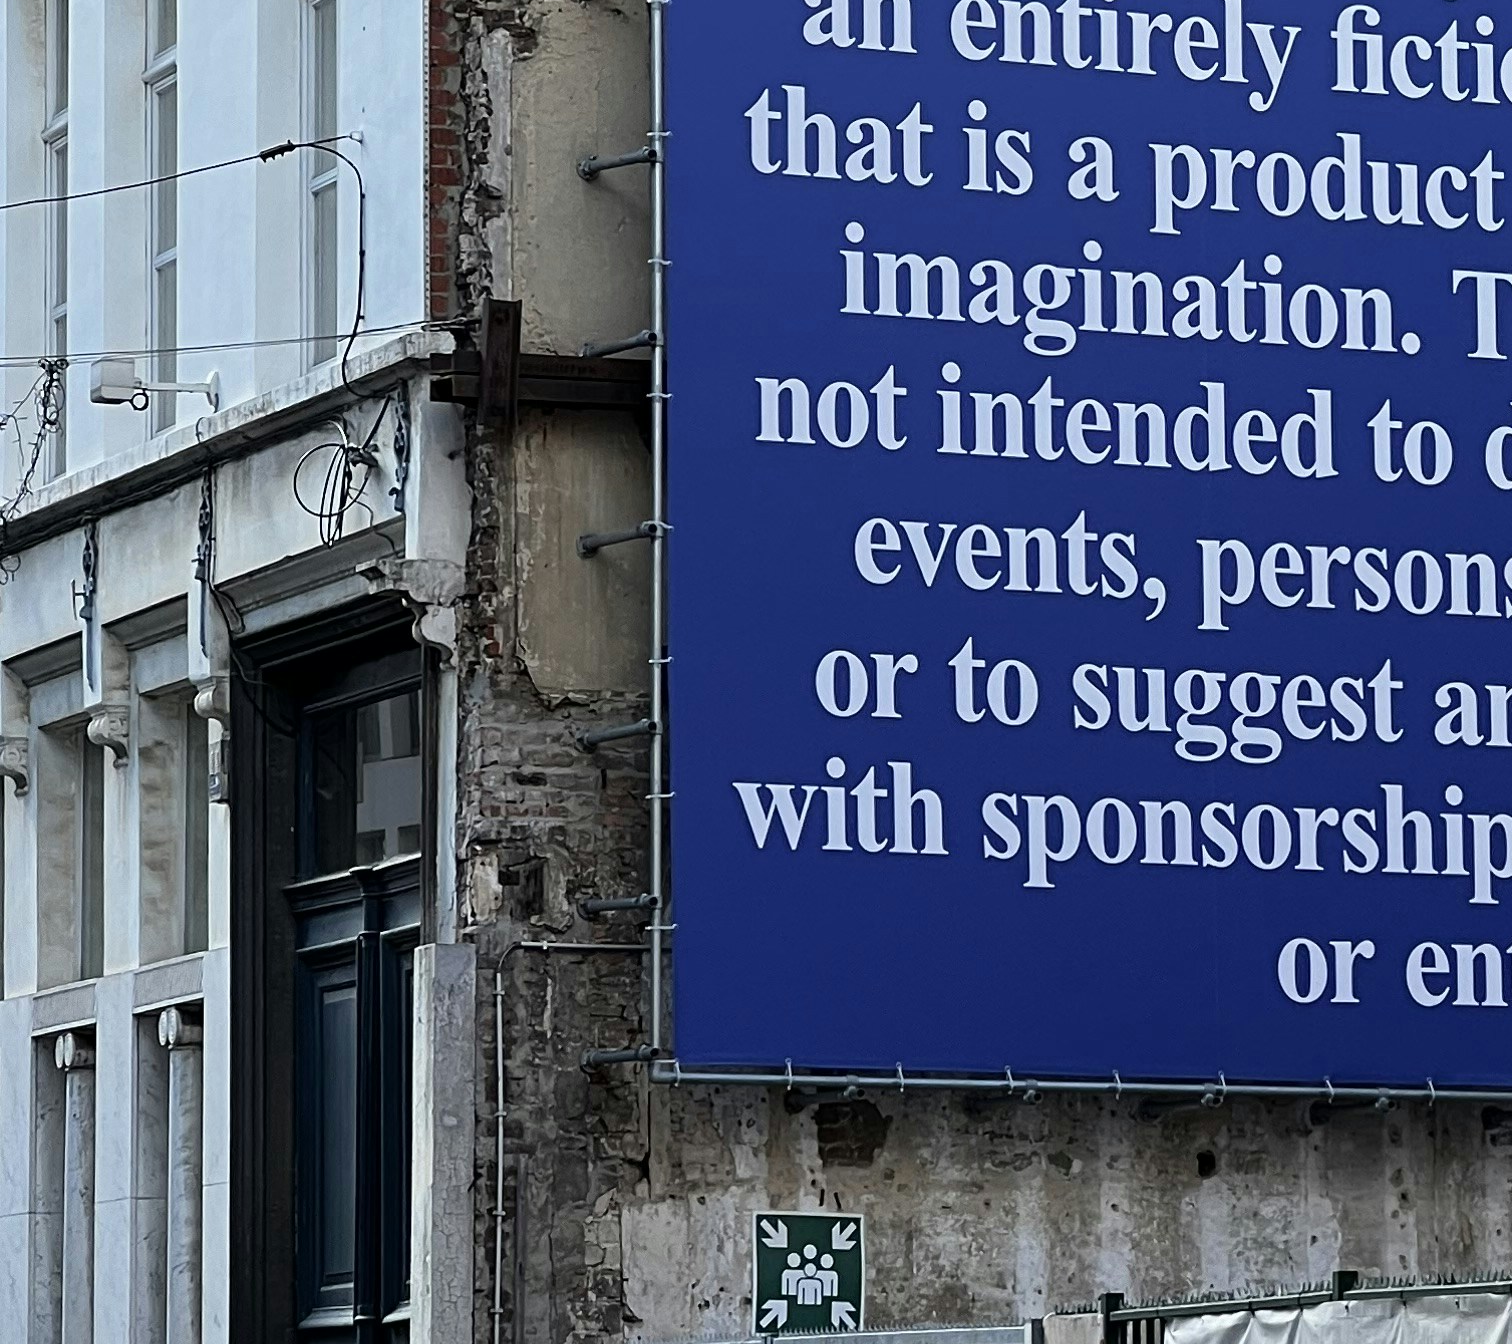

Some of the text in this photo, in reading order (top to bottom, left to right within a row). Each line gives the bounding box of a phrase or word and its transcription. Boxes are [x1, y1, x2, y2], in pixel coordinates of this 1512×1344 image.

[744, 85, 933, 186] that
[963, 100, 1033, 195] is
[1068, 137, 1119, 201] a
[1149, 133, 1504, 234] product
[840, 222, 1420, 356] imagination.
[755, 365, 907, 450] not
[937, 362, 1339, 478] intended
[1367, 399, 1452, 485] to
[855, 510, 1166, 620] events,
[816, 650, 918, 717] or
[948, 637, 1038, 725] to
[1073, 659, 1403, 763] suggest
[733, 757, 949, 854] with
[1278, 938, 1375, 1003] or
